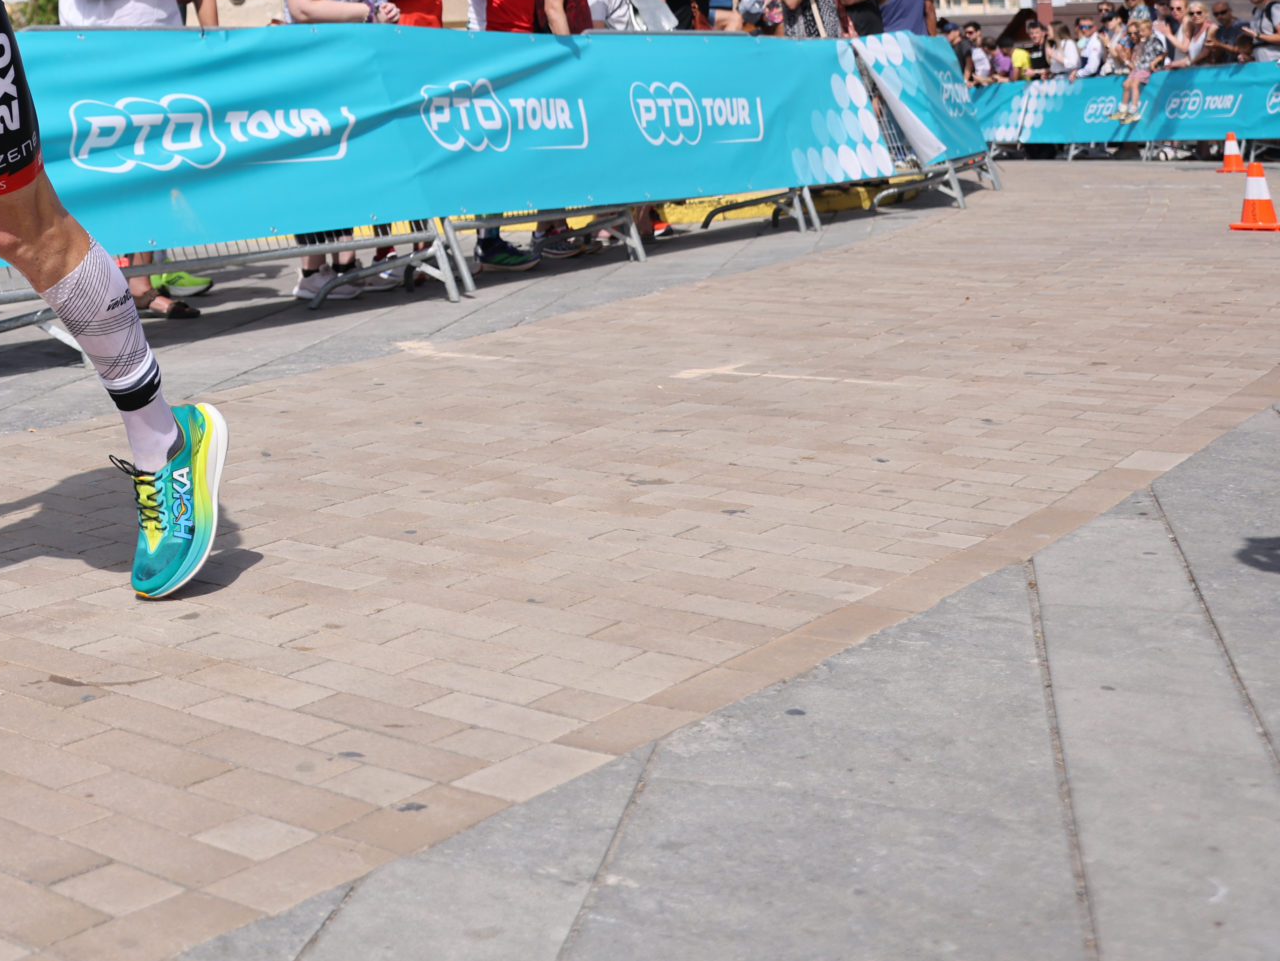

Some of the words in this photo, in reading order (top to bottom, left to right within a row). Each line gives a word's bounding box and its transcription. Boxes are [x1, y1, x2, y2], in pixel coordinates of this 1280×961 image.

[429, 97, 503, 131] PTO
[509, 97, 574, 130] TOUR
[636, 98, 695, 128] PTO
[701, 96, 752, 126] TOUR
[1086, 101, 1114, 117] PTO
[1169, 96, 1201, 112] PTO
[1204, 93, 1235, 111] TOUR
[77, 112, 204, 160] PTO
[224, 107, 332, 142] TOUR
[172, 466, 195, 540] HOKA
